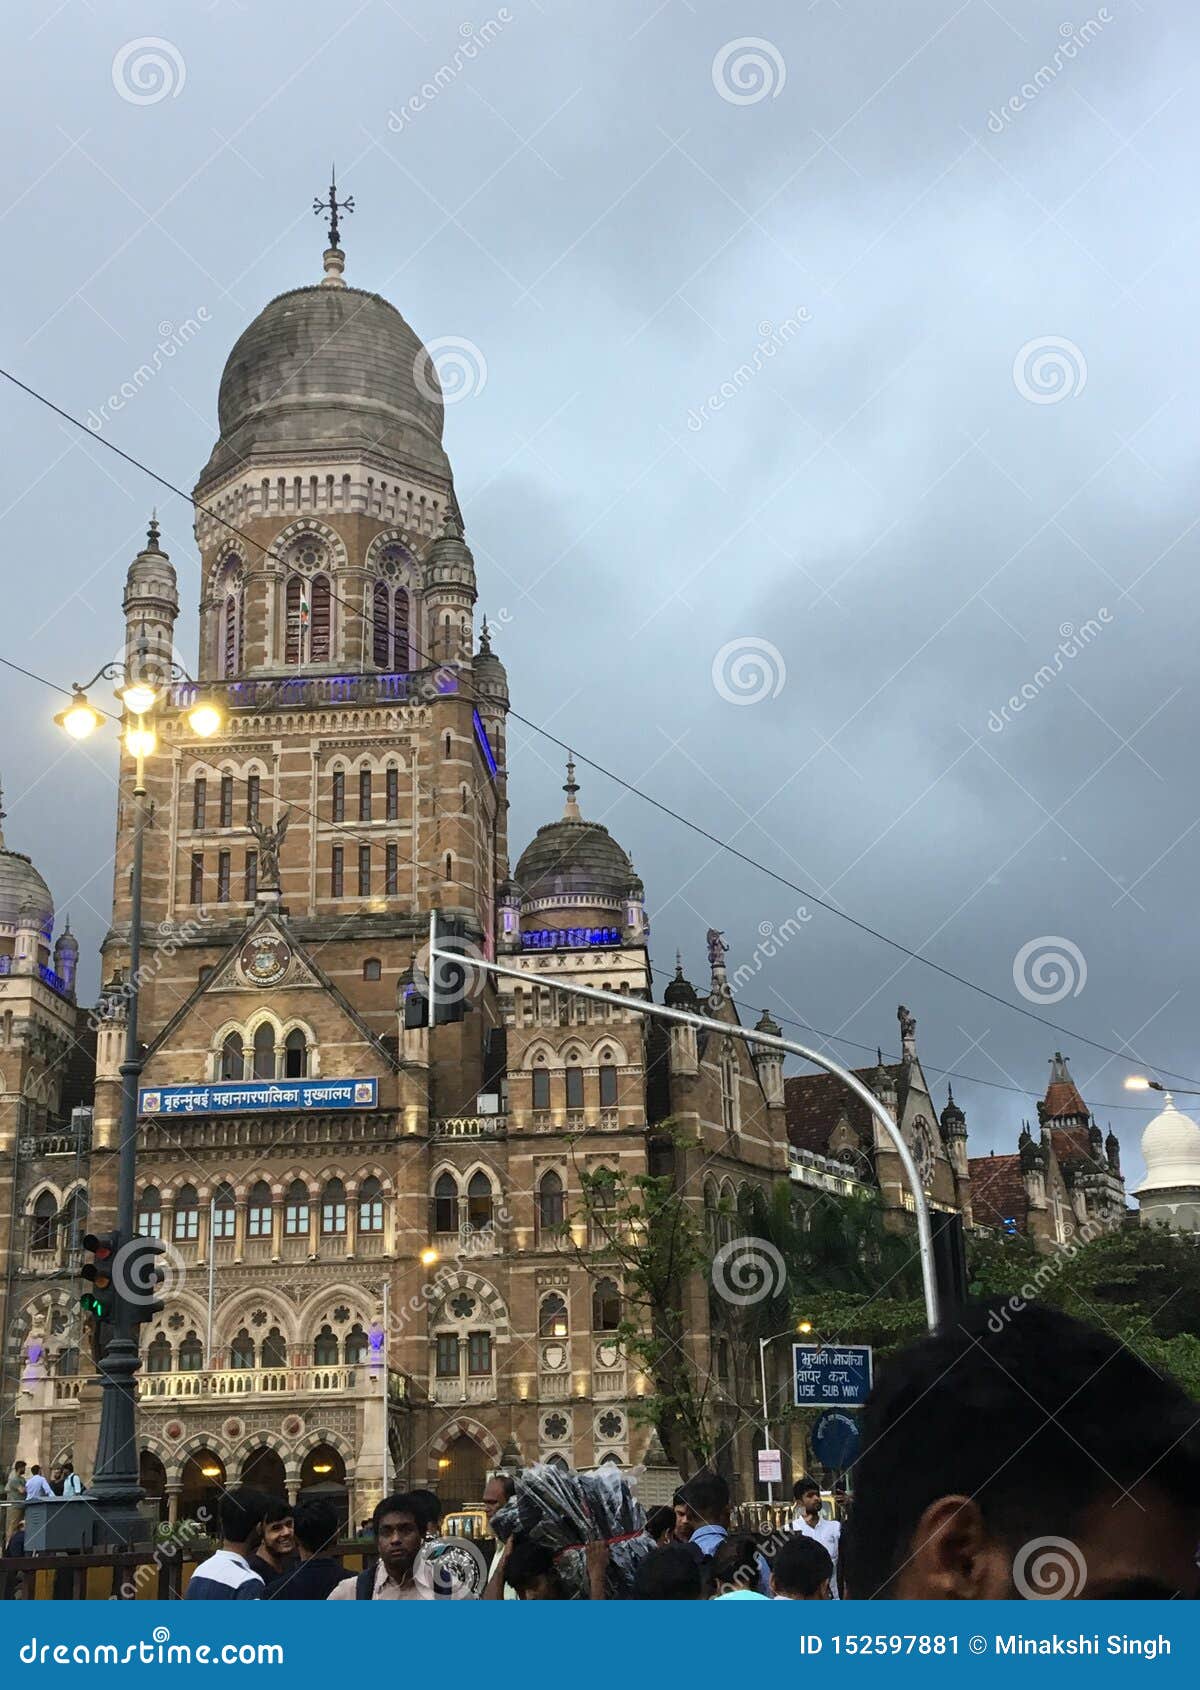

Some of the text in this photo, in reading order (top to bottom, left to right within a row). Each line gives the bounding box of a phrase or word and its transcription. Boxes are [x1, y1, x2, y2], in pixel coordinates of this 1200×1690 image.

[164, 1086, 353, 1112] बृहन्मुंबई महानगरपालिका मुख्यालय
[797, 1370, 821, 1384] वापर
[800, 1384, 859, 1397] USE SUB WAY
